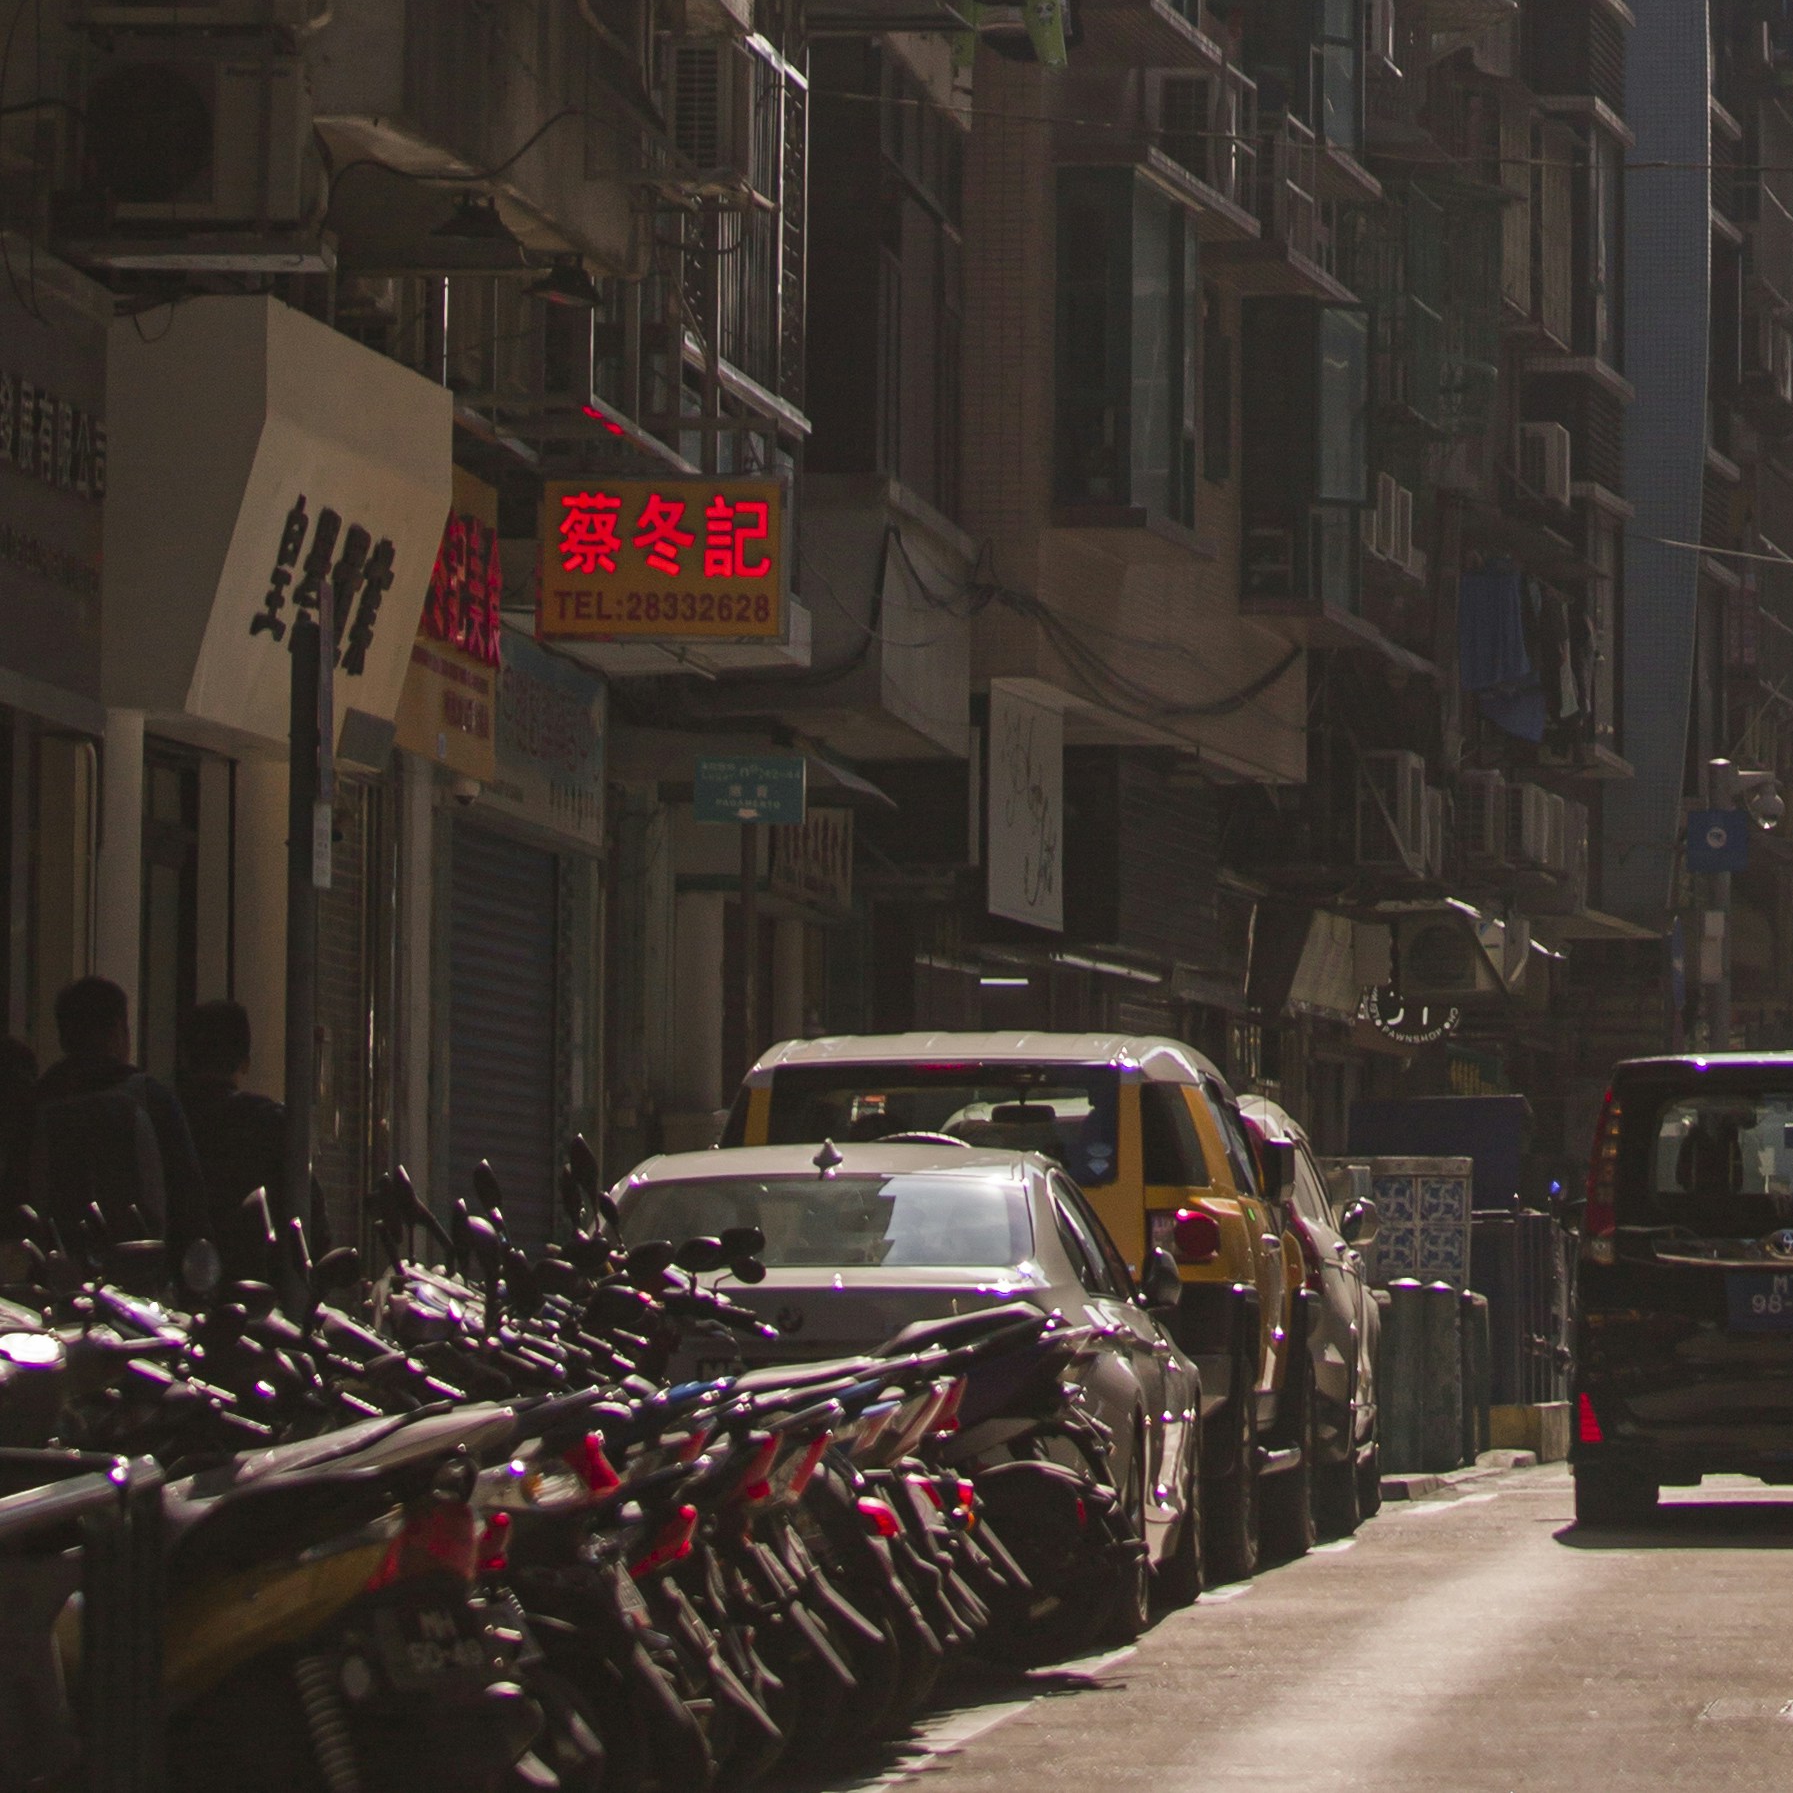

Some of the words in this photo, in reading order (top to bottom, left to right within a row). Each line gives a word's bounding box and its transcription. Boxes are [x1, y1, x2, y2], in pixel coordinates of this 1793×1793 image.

[559, 491, 772, 579] 蔡冬記
[554, 590, 771, 623] TEL:28332628
[1381, 1025, 1443, 1043] PAWNSHOP
